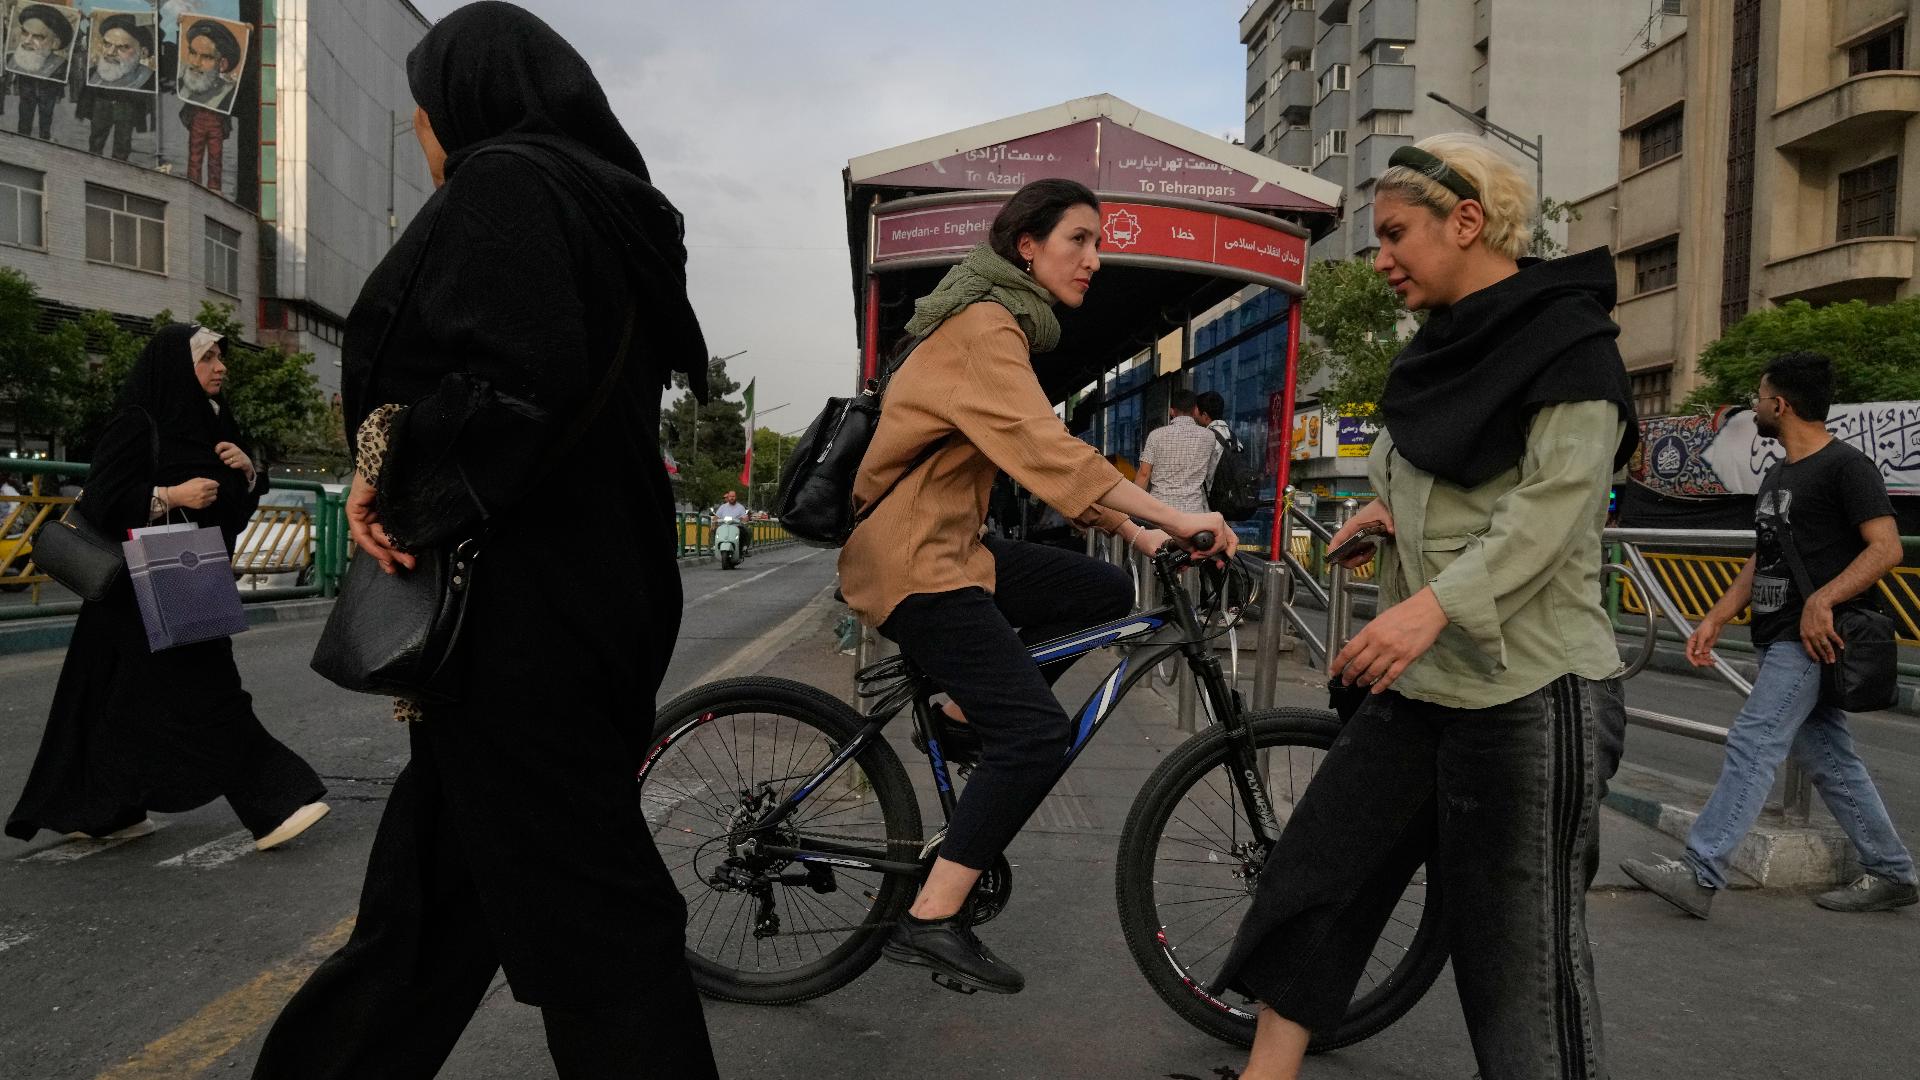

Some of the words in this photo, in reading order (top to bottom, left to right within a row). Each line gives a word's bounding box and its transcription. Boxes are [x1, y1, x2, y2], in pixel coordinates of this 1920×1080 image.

[965, 144, 1007, 163] آزادی
[1008, 149, 1044, 161] سمت
[987, 171, 1025, 186] Azadi
[1139, 179, 1155, 192] To
[1158, 180, 1236, 198] Tehranpars
[892, 226, 940, 241] Meydan-e
[1224, 237, 1256, 251] اسلامی
